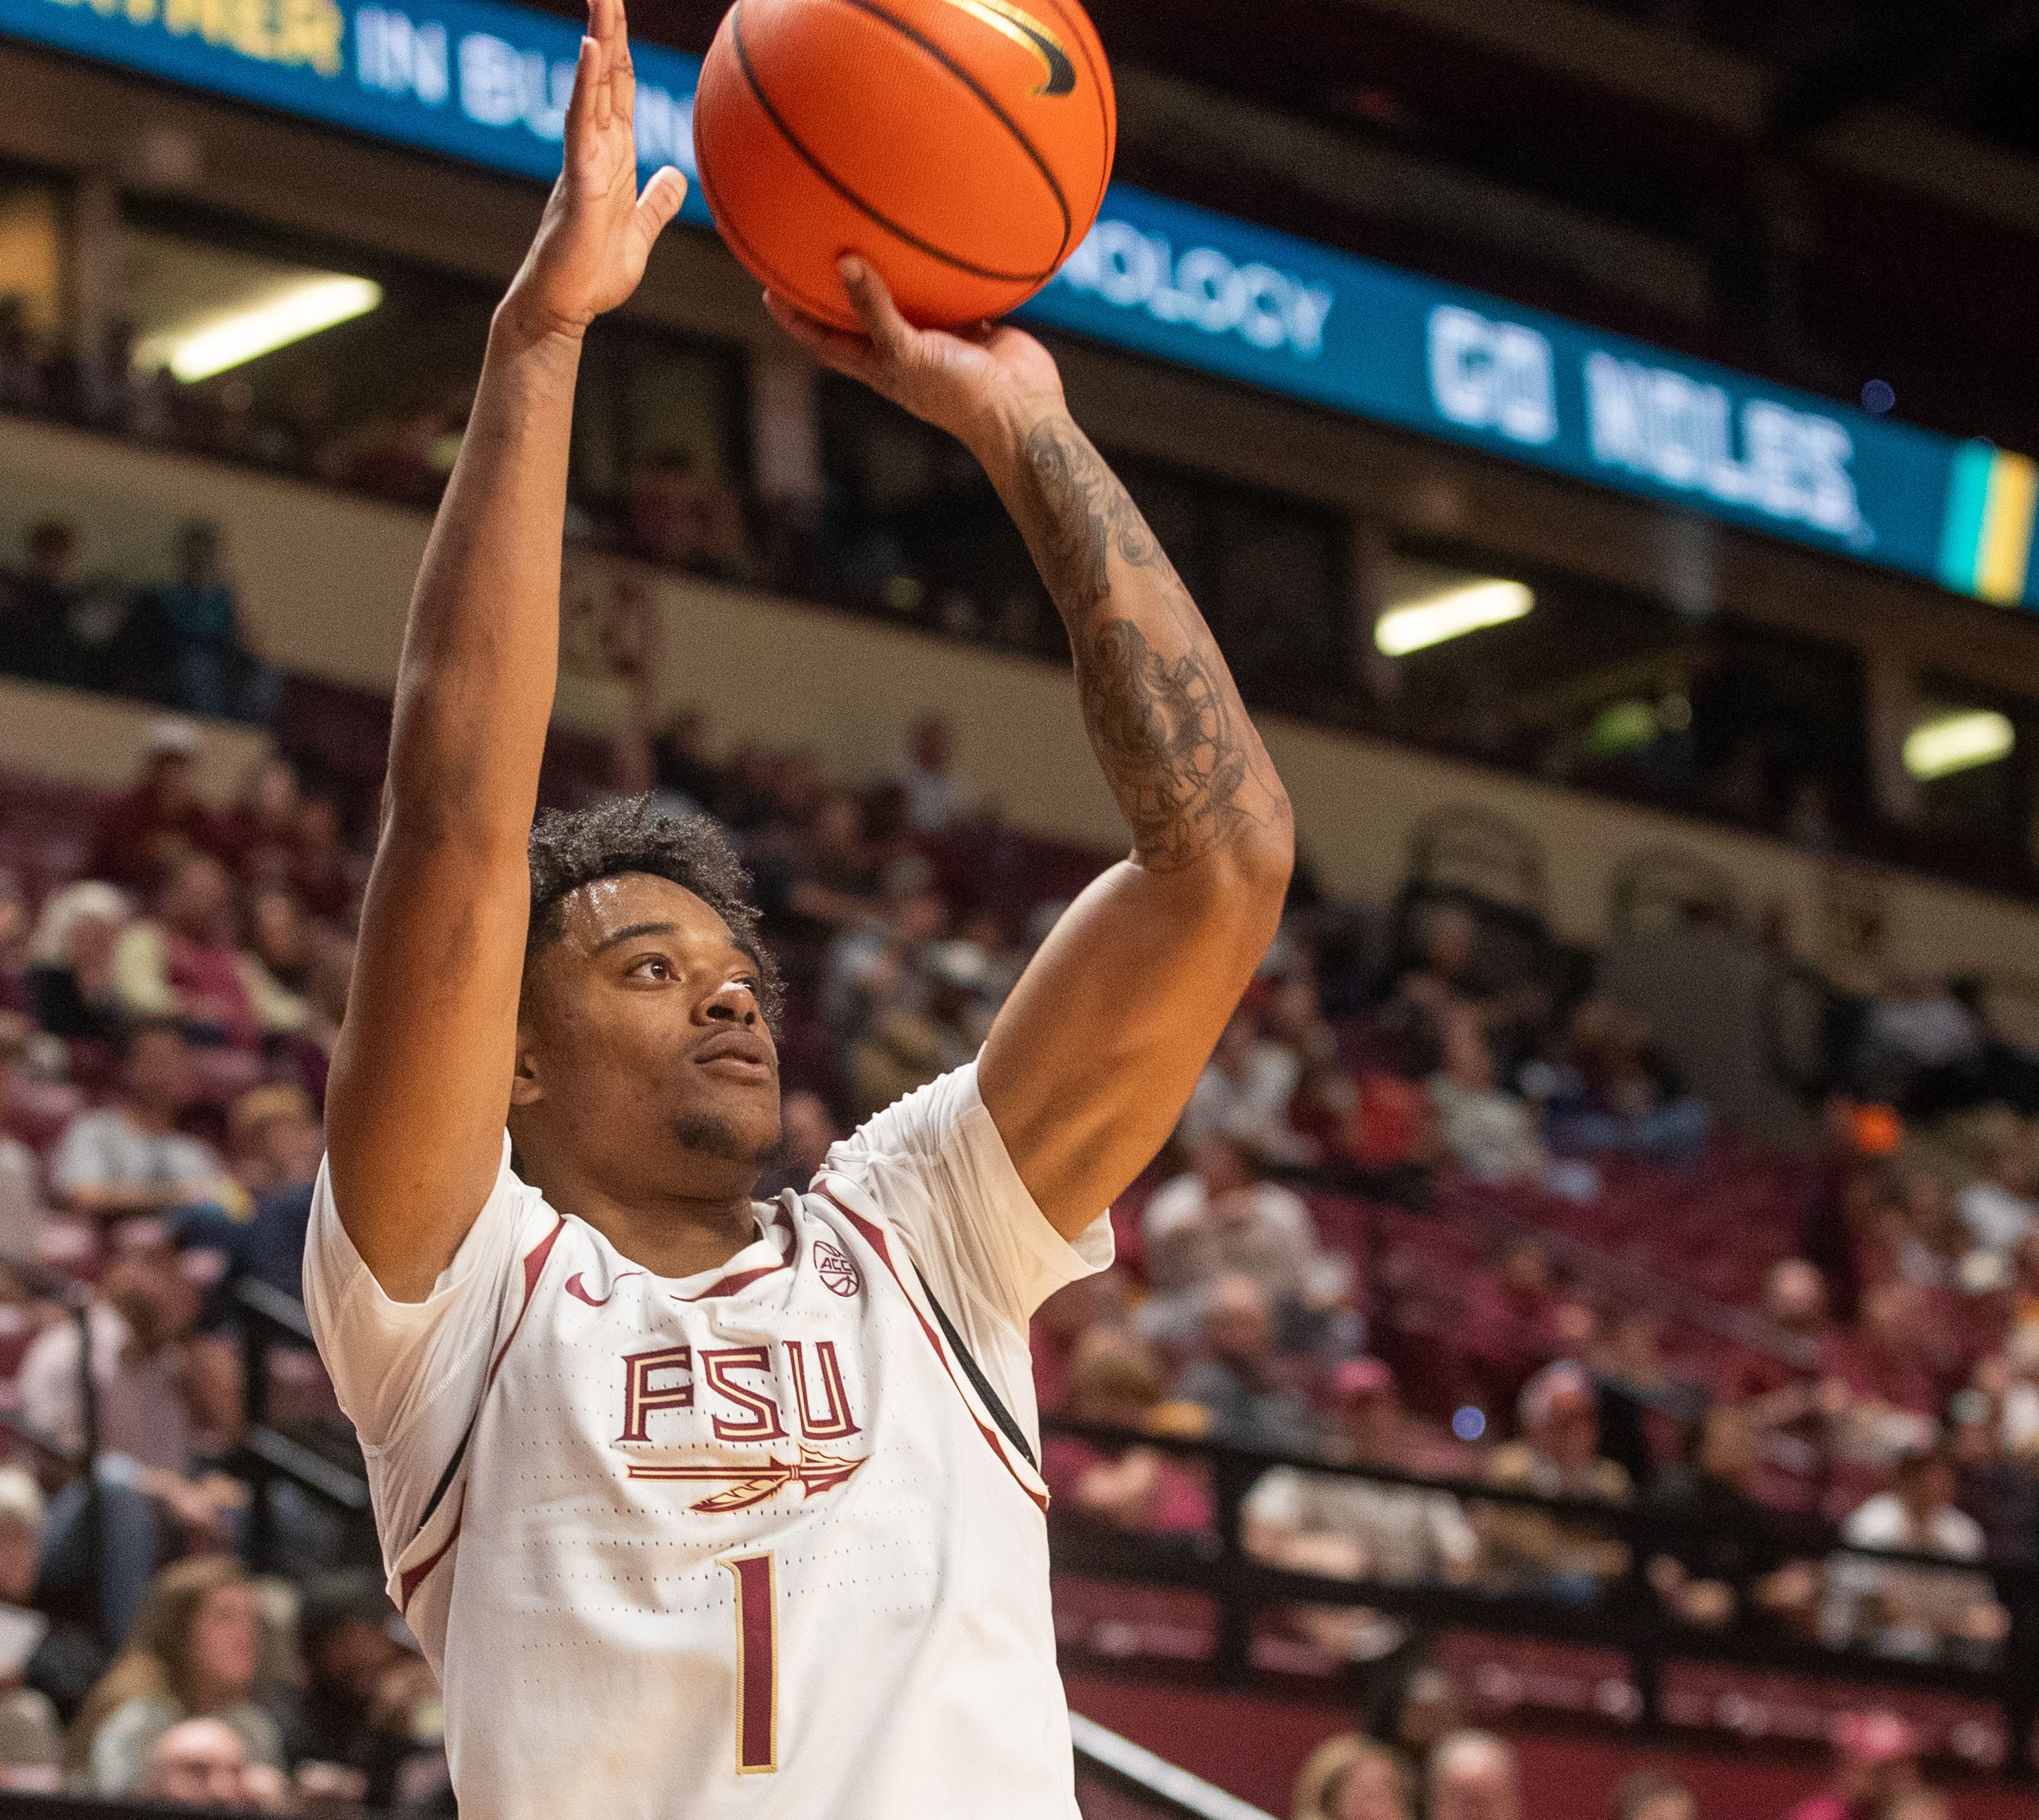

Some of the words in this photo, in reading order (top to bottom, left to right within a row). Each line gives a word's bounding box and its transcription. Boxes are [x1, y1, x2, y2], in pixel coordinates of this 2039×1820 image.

[355, 5, 451, 106] IN
[1429, 304, 1557, 445] GO
[1585, 351, 1859, 534] NOLES
[820, 1257, 852, 1271] ACC
[616, 1340, 862, 1442] FSU
[715, 1550, 778, 1775] 1
